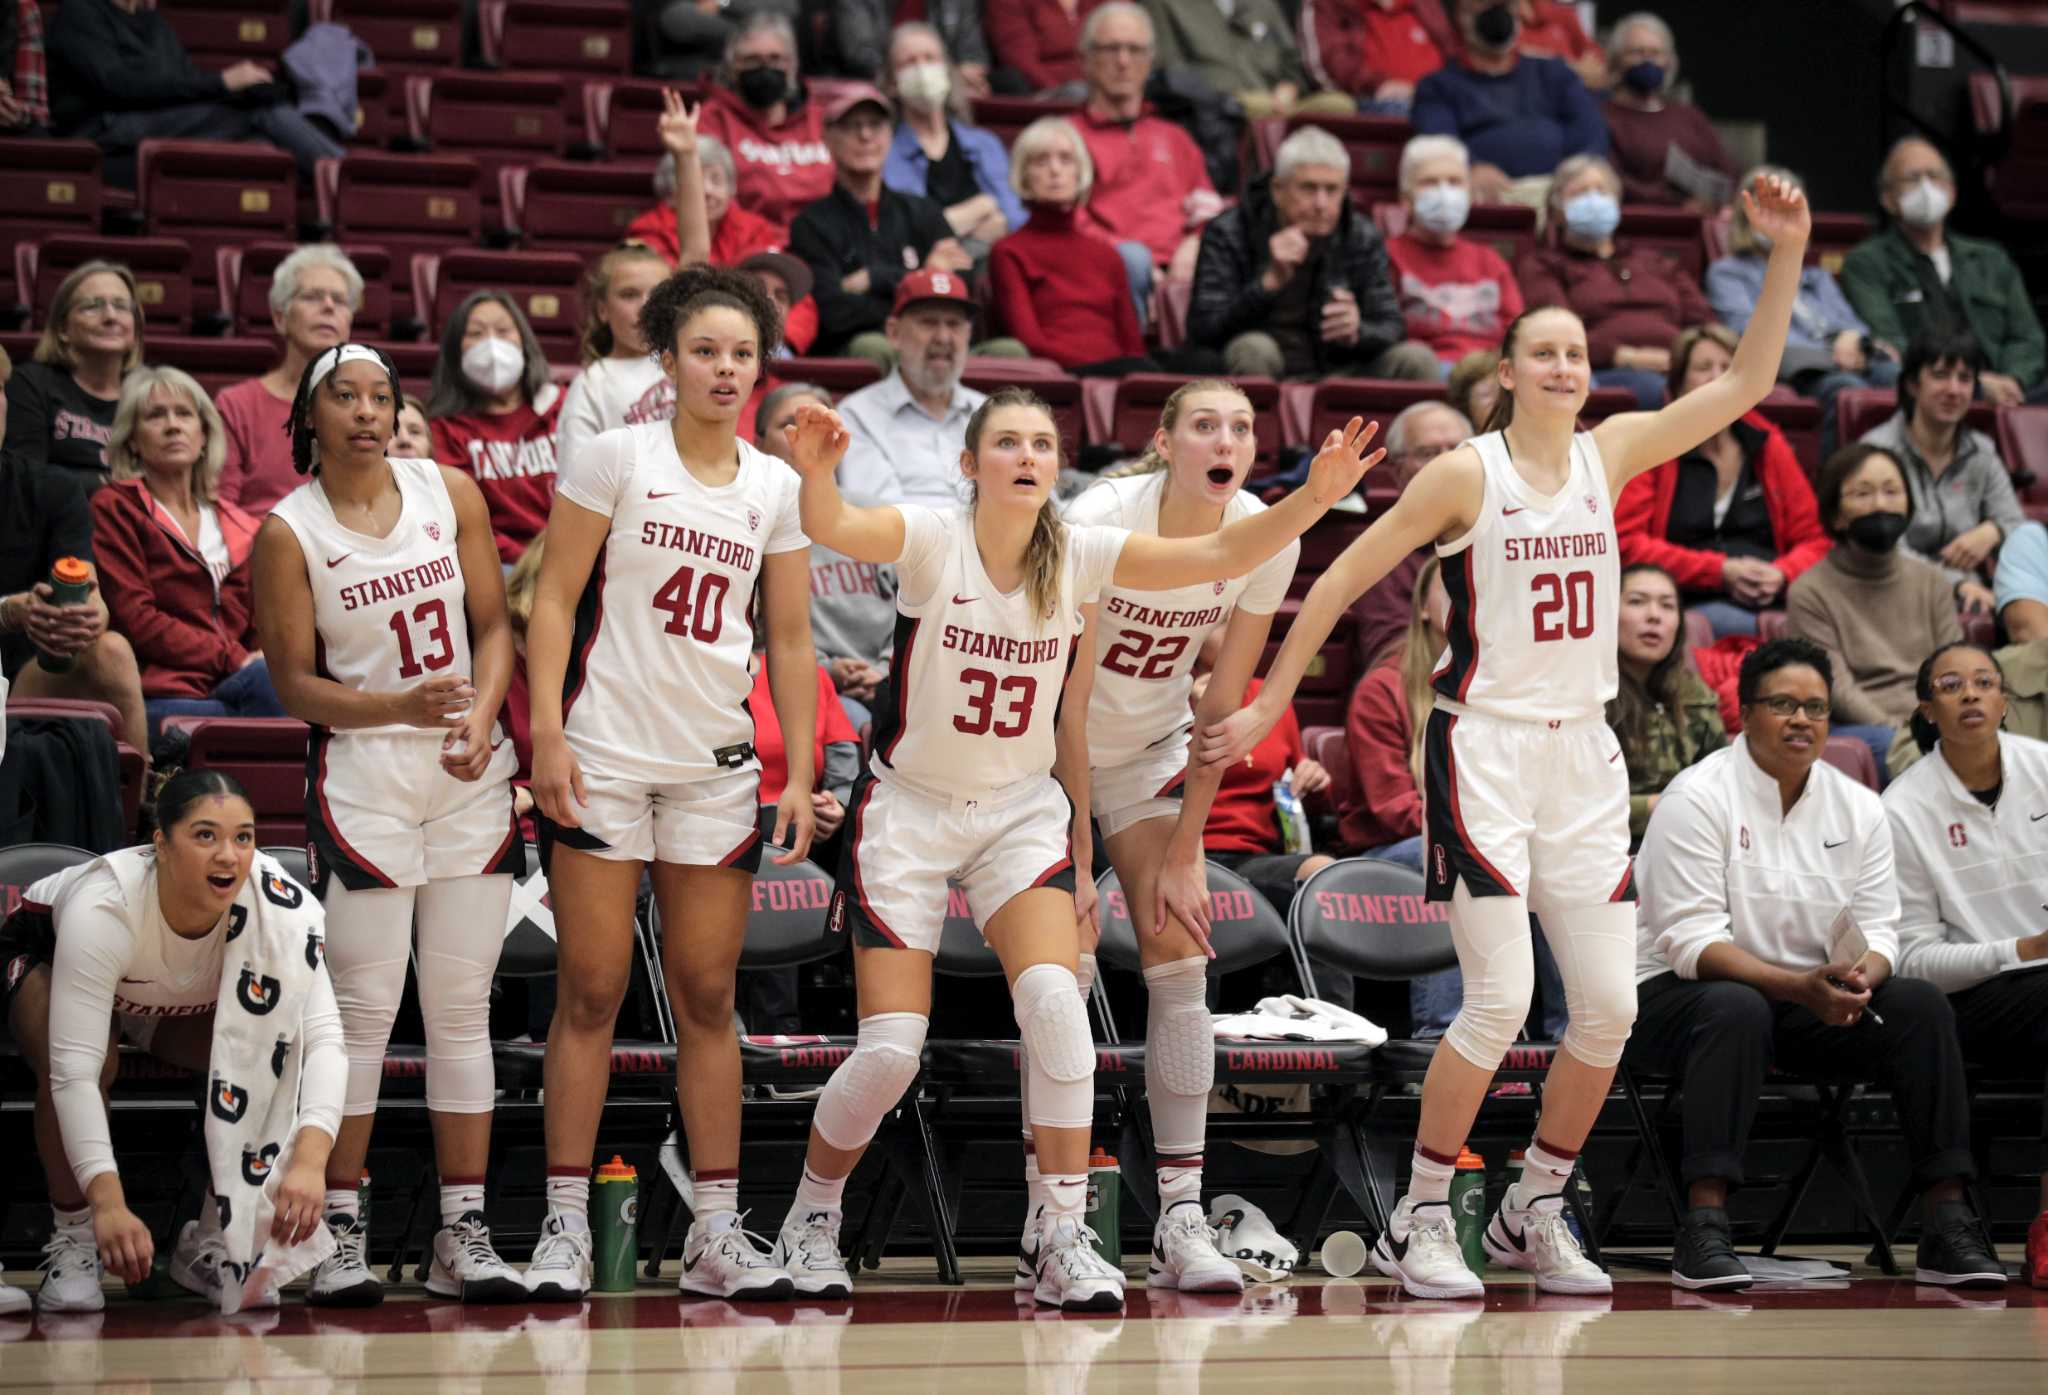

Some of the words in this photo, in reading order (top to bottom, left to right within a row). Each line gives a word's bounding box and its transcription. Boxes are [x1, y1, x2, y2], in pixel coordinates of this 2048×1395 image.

[641, 521, 754, 572] STANFORD
[1504, 532, 1607, 562] STANFORD
[340, 556, 455, 611] STANFORD
[652, 565, 730, 645] 40
[1530, 570, 1594, 643] 20
[1107, 597, 1222, 629] STANFORD
[389, 598, 455, 679] 13
[942, 624, 1059, 665] STANFORD
[1101, 629, 1190, 679] 22
[952, 668, 1038, 738] 33
[749, 878, 830, 912] FORD
[1226, 1050, 1340, 1072] CARDINAL
